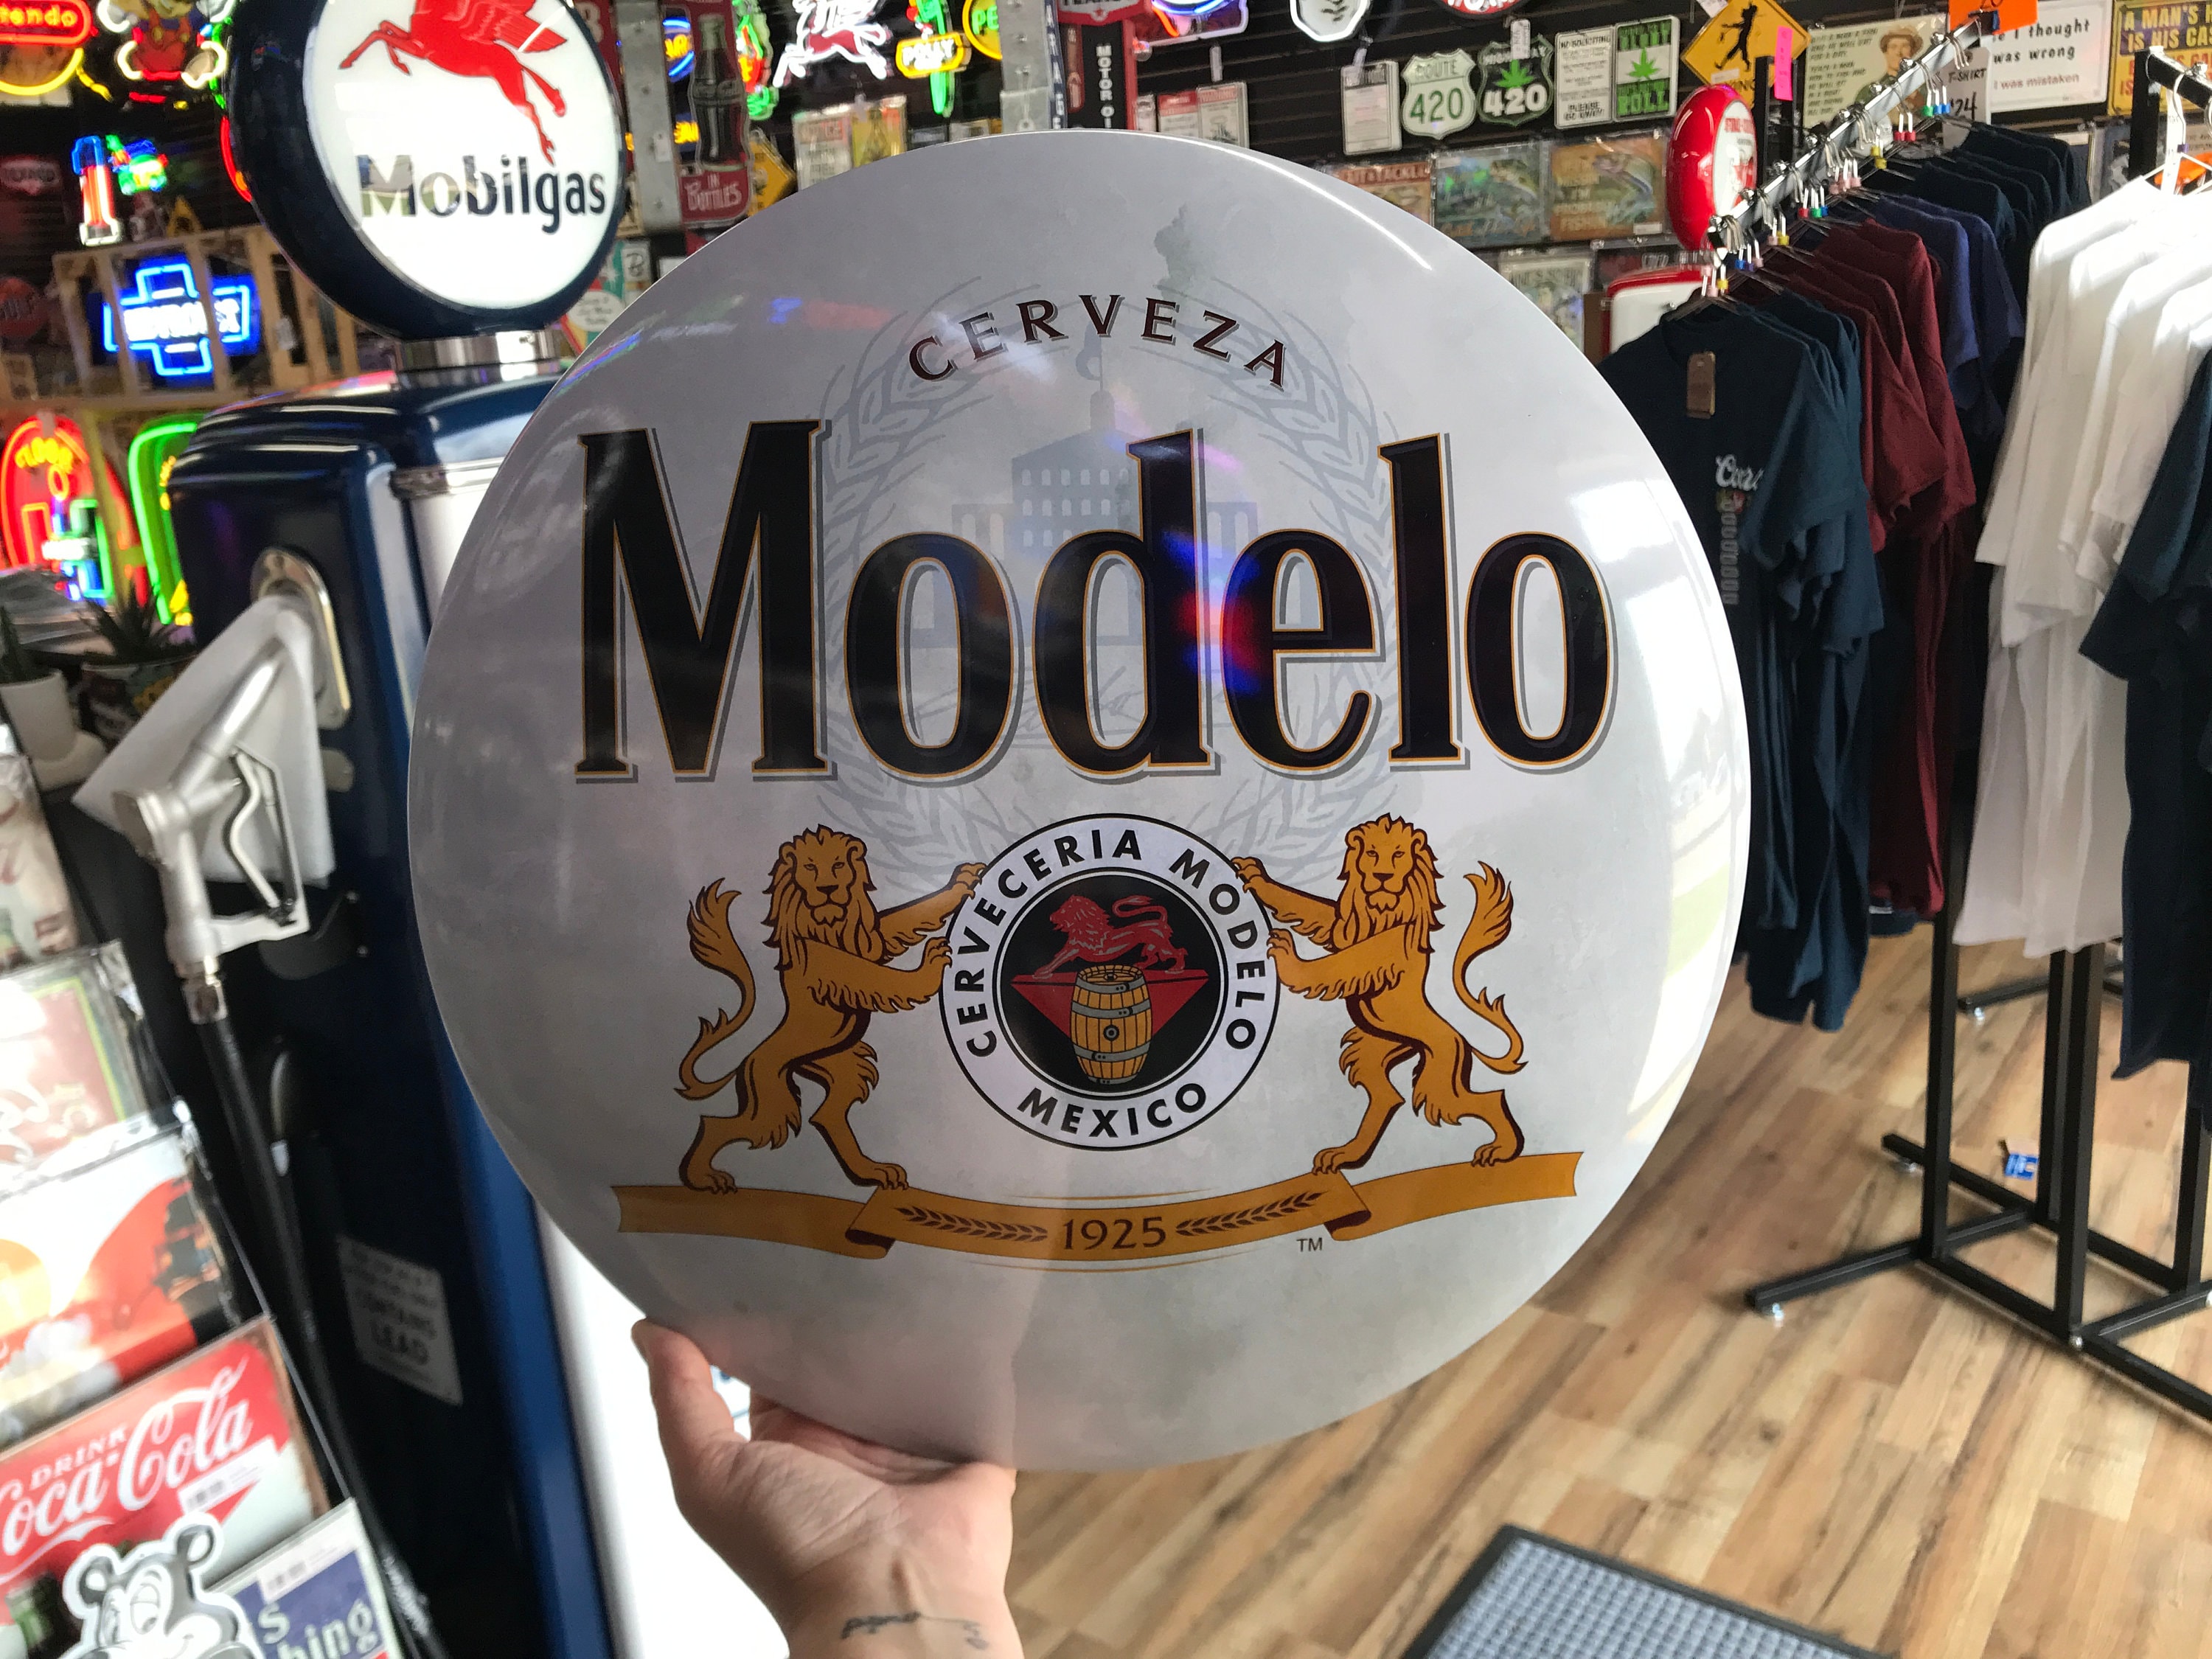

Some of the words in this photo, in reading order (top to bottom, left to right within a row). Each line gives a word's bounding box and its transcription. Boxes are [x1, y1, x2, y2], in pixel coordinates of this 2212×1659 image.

[2029, 17, 2090, 38] thought
[2124, 10, 2135, 31] A
[2141, 4, 2199, 29] MAN'S
[1993, 51, 2021, 64] was
[2029, 46, 2076, 60] wrong
[2127, 33, 2145, 52] IS
[2152, 29, 2180, 49] HIS
[1096, 44, 1113, 102] MOTOR
[1948, 68, 1987, 83] T-SHIRT
[1993, 81, 1997, 90] I
[2000, 78, 2024, 90] was
[2026, 73, 2081, 88] mistaken
[1410, 88, 1464, 124] 420
[1483, 83, 1548, 116] 420
[1100, 105, 1115, 129] OI
[356, 154, 607, 234] Mobilgas
[909, 294, 1286, 390] CERVEZA
[574, 419, 1616, 787] Modelo
[954, 830, 1141, 1057] CERVECERIA
[1168, 849, 1266, 1051] MODELO
[1016, 1082, 1207, 1139] MEXICO
[1062, 1216, 1167, 1251] 1925
[1296, 1237, 1324, 1253] TM
[29, 1424, 128, 1490] DRINK
